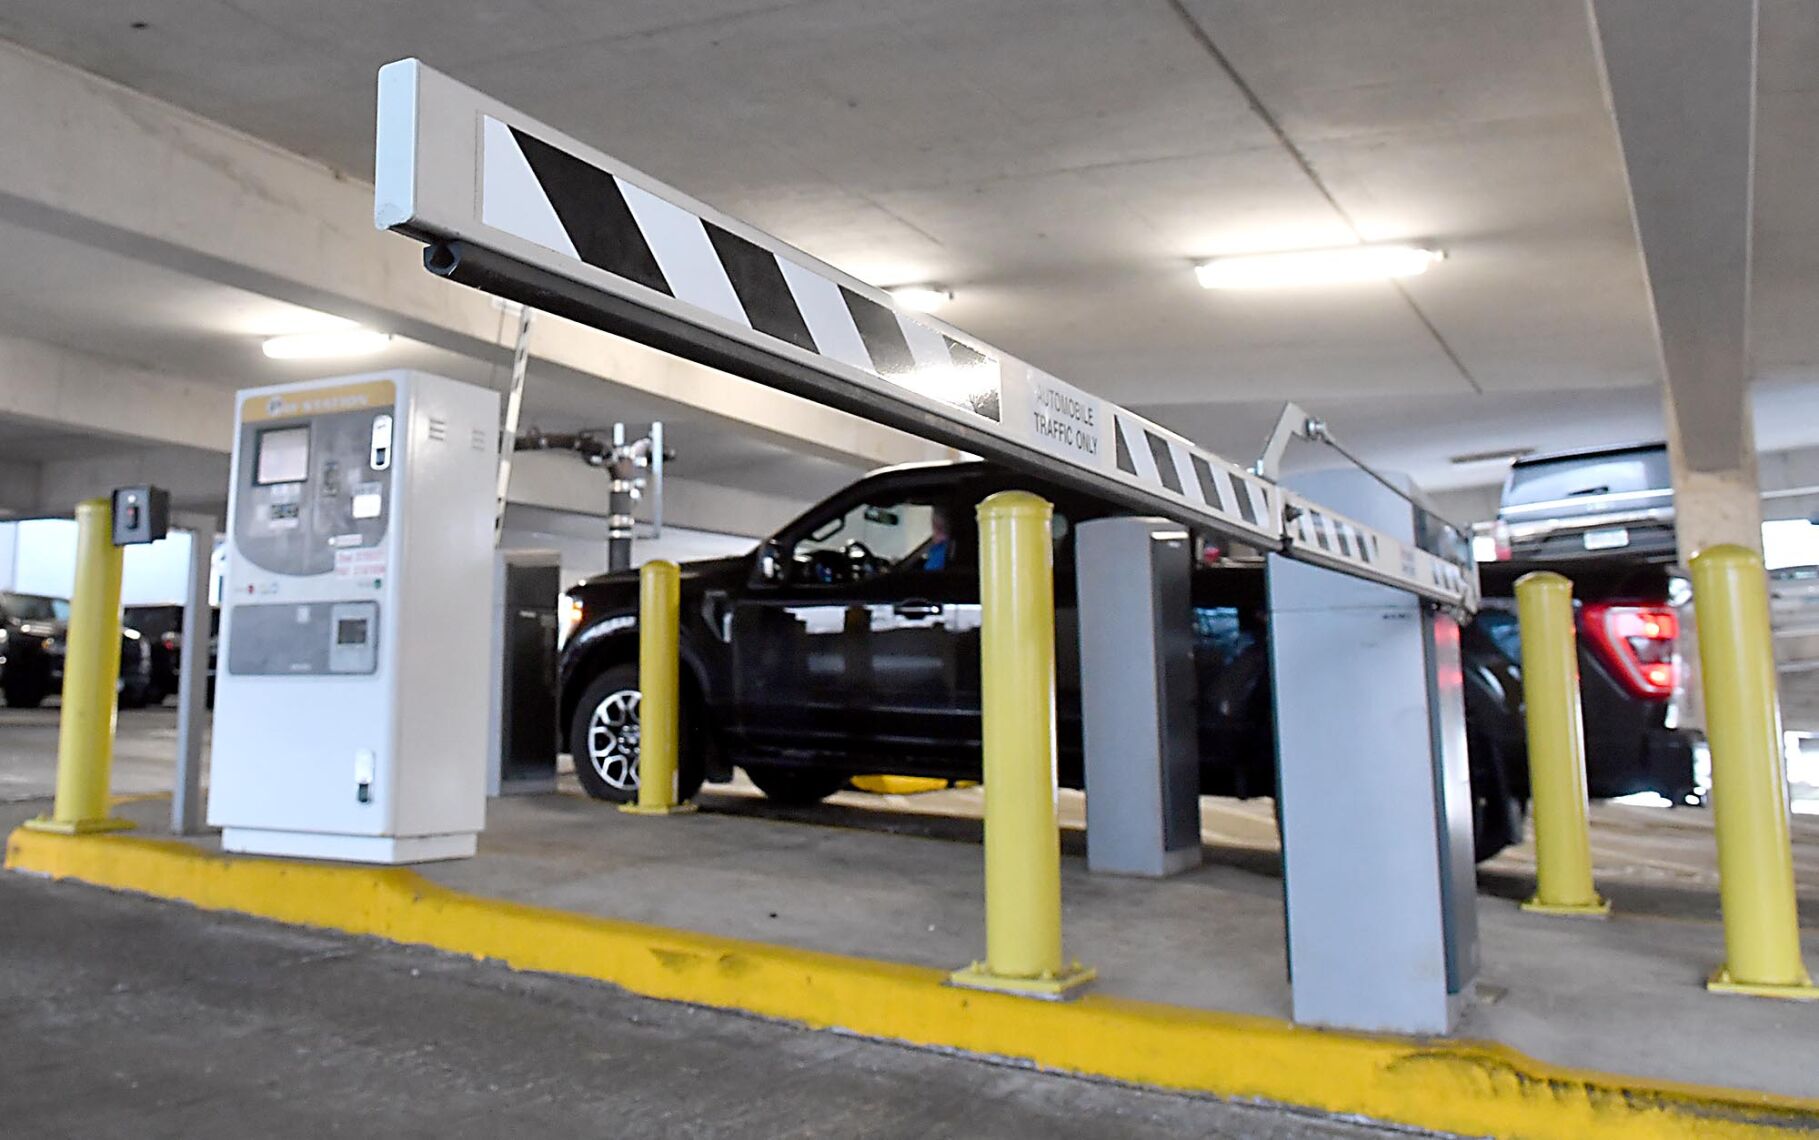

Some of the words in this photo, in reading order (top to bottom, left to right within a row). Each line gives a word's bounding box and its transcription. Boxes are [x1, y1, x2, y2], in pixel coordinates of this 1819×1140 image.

[1037, 386, 1094, 427] AUTOMOBILE
[1034, 411, 1073, 446] TRAFFIC
[1076, 430, 1098, 455] ONLY
